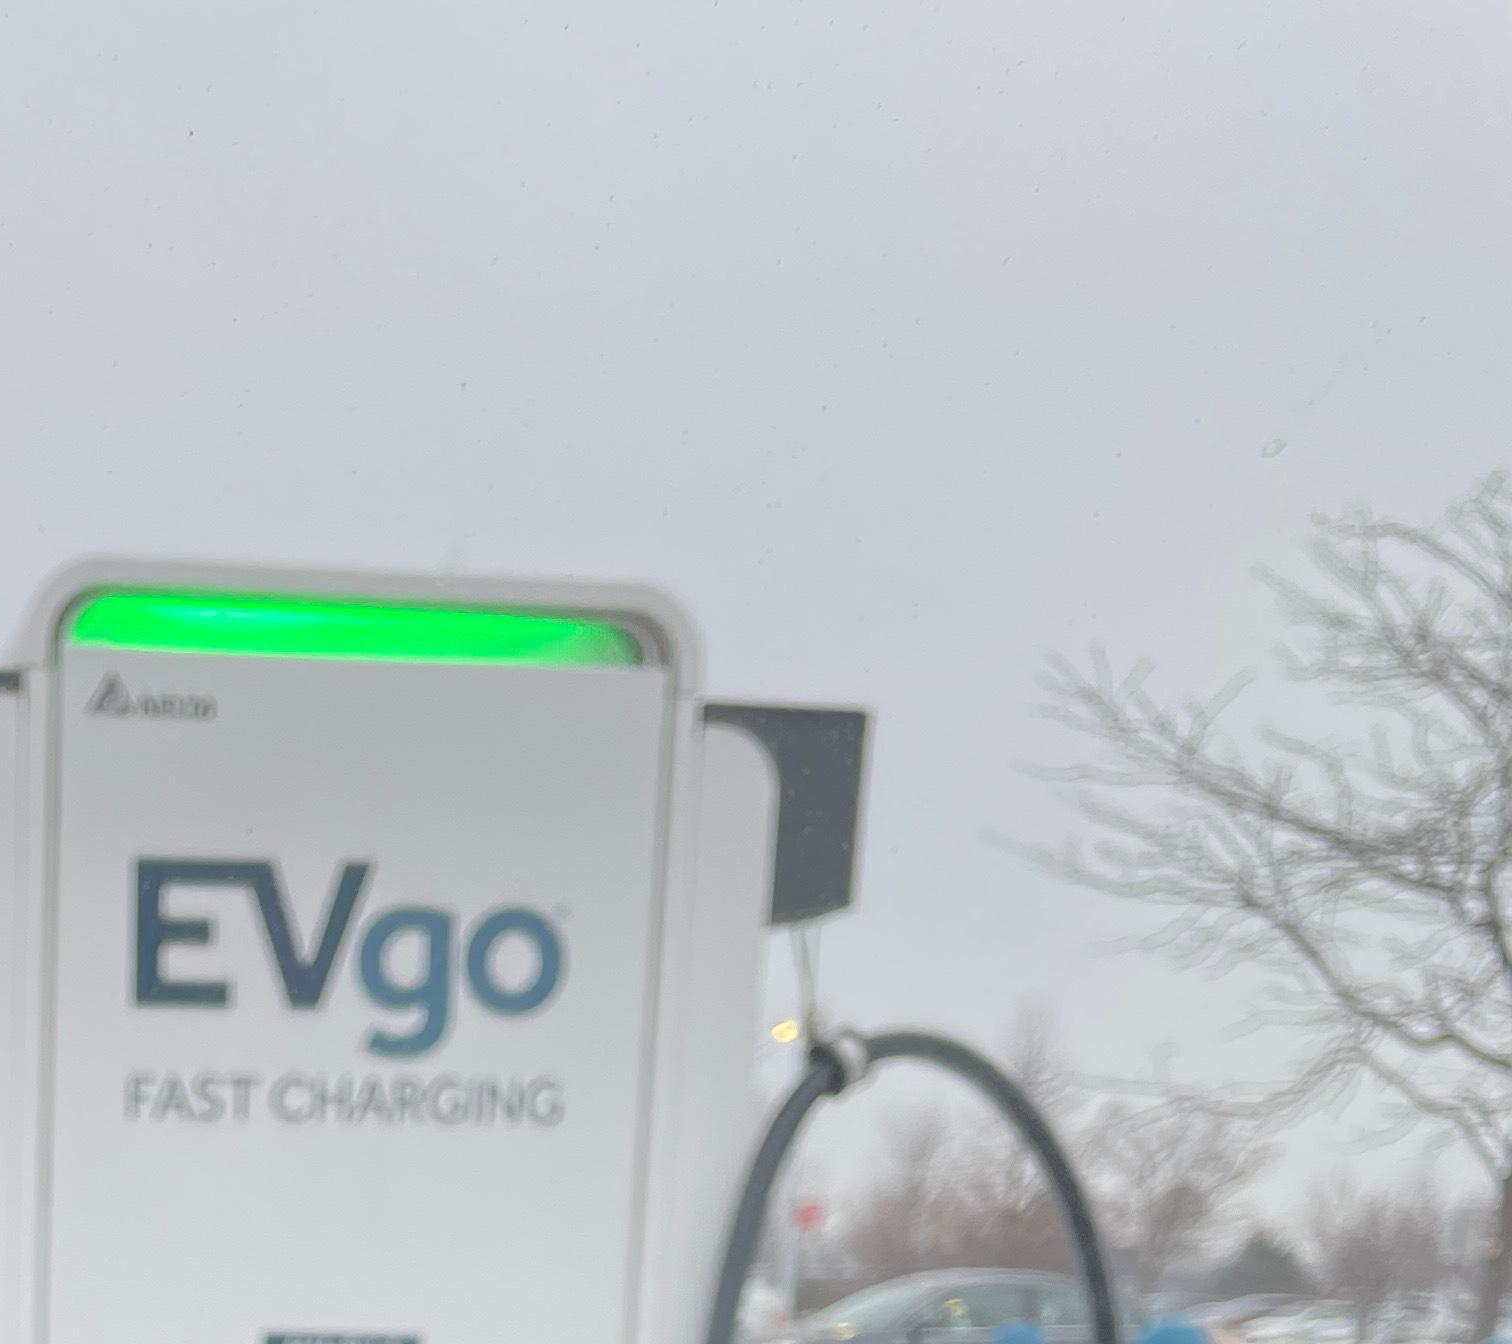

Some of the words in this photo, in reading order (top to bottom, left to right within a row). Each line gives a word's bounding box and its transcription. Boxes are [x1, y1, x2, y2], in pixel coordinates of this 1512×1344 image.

[133, 857, 567, 1057] EVgo
[123, 1069, 262, 1124] FAST
[268, 1070, 565, 1128] CHARGING
